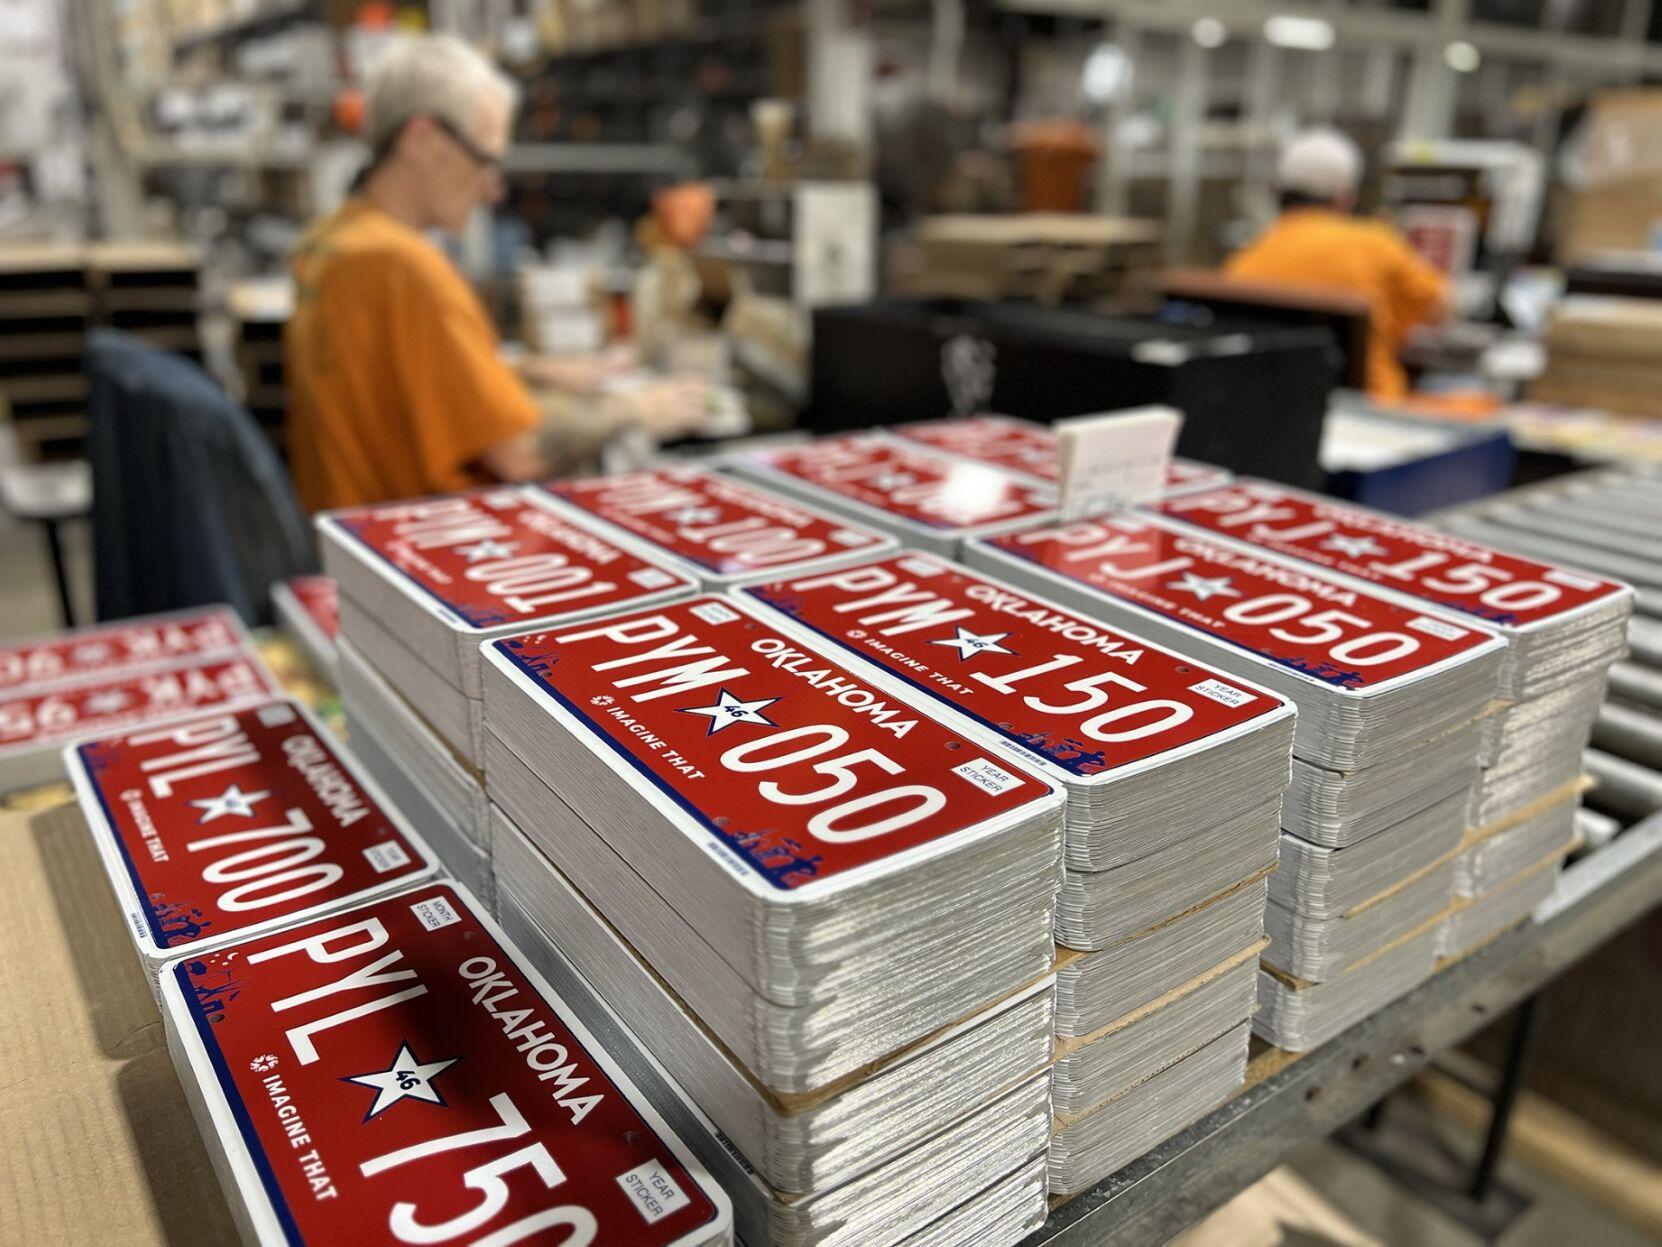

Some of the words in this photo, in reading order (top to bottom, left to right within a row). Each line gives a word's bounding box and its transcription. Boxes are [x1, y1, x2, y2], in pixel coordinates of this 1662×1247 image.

[678, 516, 826, 565] 100
[464, 552, 618, 613] 001
[790, 566, 976, 637] PYM
[1017, 523, 1194, 580] PYJ
[1222, 593, 1421, 666] 050
[1367, 550, 1563, 610] 150
[965, 585, 1145, 665] OKLAHOMA
[966, 638, 988, 648] 46
[555, 614, 751, 703] PYM
[751, 638, 920, 739] OKLAHOMA
[864, 638, 929, 673] IMAGINE
[929, 671, 974, 695] THAT
[723, 704, 749, 718] 46
[968, 653, 1194, 743] 150
[1195, 685, 1240, 705] STICKER
[1215, 684, 1242, 698] YEAR
[127, 714, 261, 799] PYL
[607, 706, 668, 751] IMAGINE
[661, 749, 706, 780] THAT
[981, 764, 1009, 782] YEAR
[720, 724, 947, 843] 050
[960, 766, 1003, 792] STICKER
[186, 807, 344, 912] 700
[417, 904, 440, 927] STICKER
[432, 900, 454, 921] MONTH
[246, 916, 429, 1066] PYL
[396, 1070, 421, 1091] 46
[458, 956, 605, 1126] OKLAHOMA
[262, 1074, 312, 1149] IMAGINE
[299, 1149, 339, 1201] THAT
[625, 1173, 664, 1216] STICKER
[648, 1171, 675, 1200] YEAR
